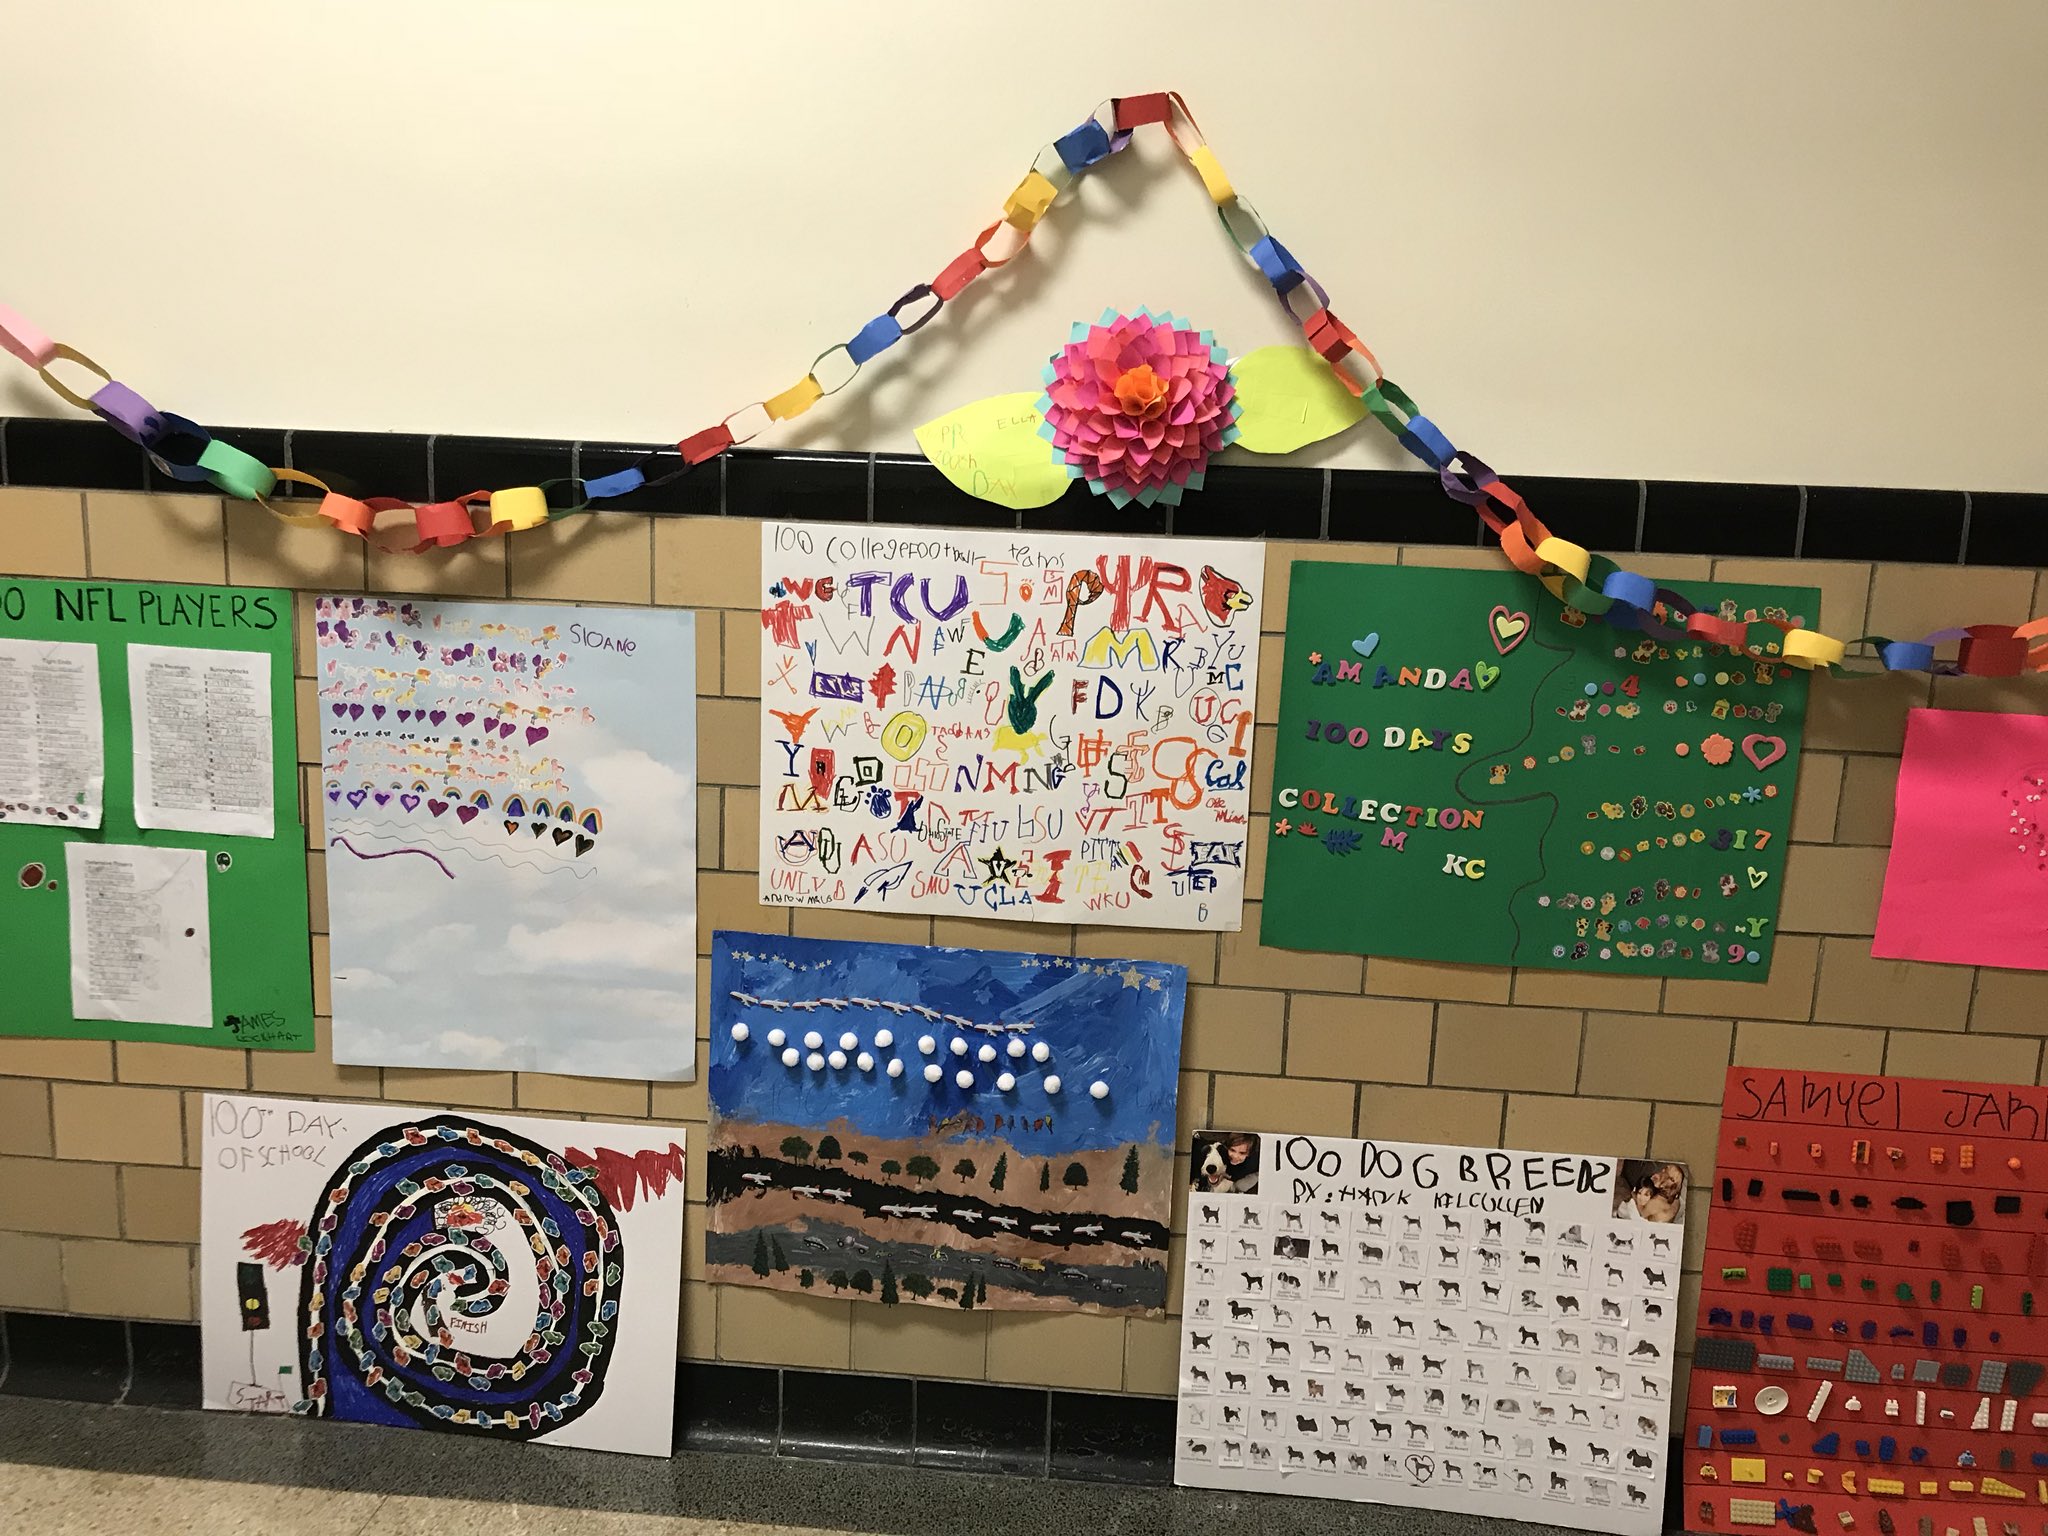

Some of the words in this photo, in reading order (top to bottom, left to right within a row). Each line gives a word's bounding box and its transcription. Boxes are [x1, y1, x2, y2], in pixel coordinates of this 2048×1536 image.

[775, 525, 814, 555] 100
[54, 587, 127, 623] NFL
[138, 590, 278, 629] PLAYERS
[850, 571, 970, 624] TCU
[1095, 675, 1124, 719] D
[1305, 719, 1369, 748] 100
[1383, 726, 1473, 754] DAYS
[1278, 788, 1485, 831] COLLECTION
[1380, 827, 1408, 852] M
[1441, 853, 1486, 880] KC
[953, 882, 1033, 912] UCLA
[1275, 1136, 1342, 1177] 100
[1360, 1141, 1439, 1189] DOG
[449, 1316, 488, 1334] FINISH
